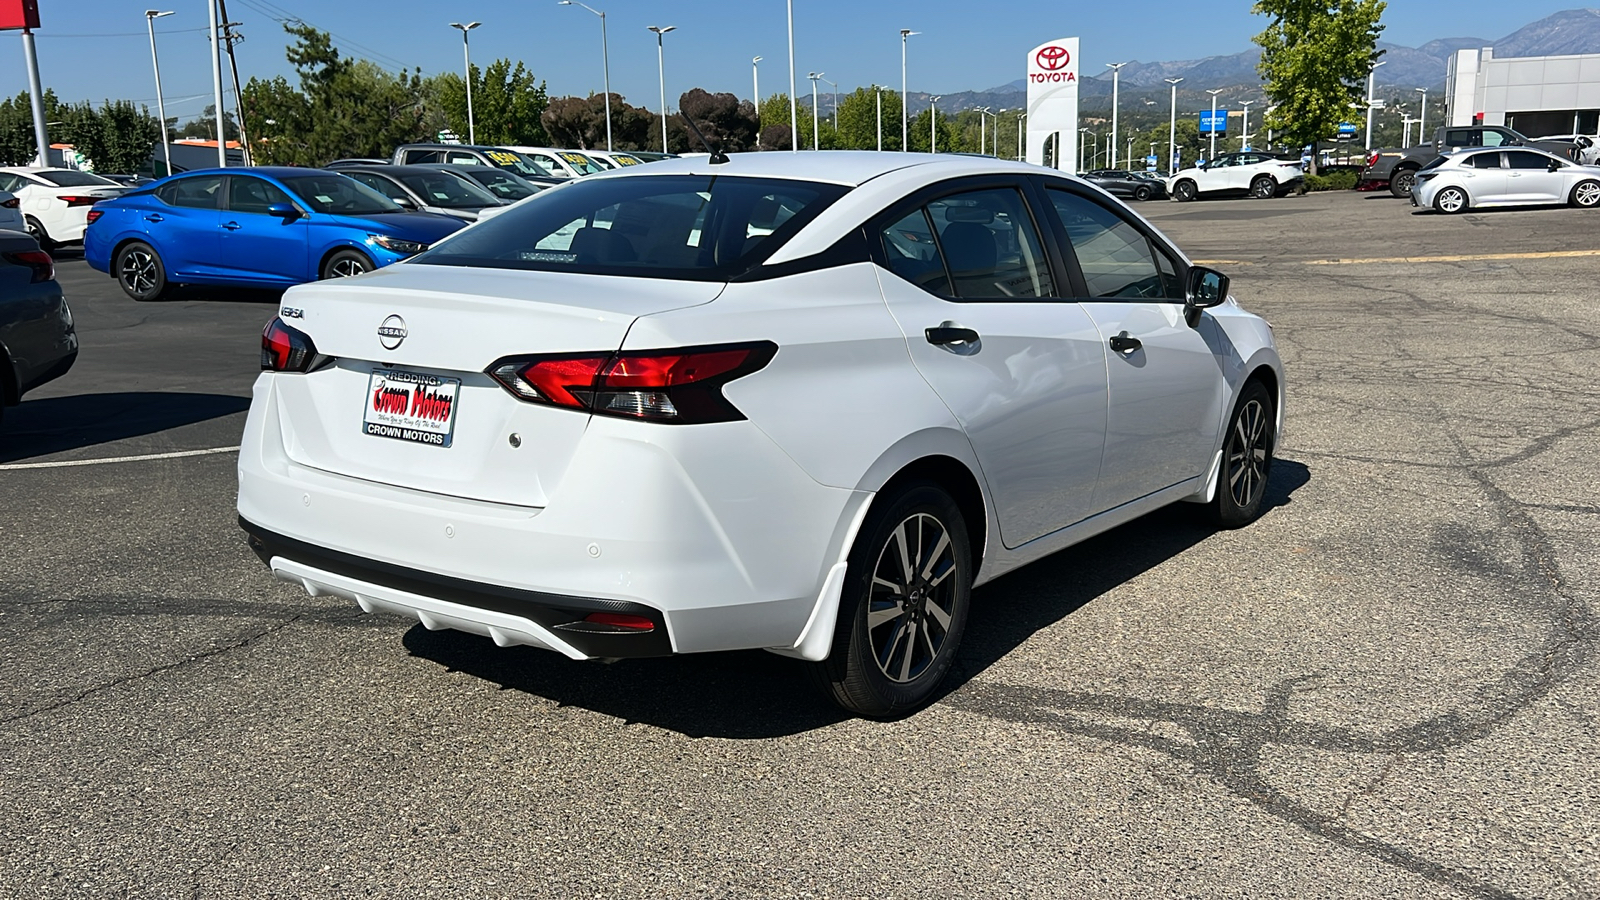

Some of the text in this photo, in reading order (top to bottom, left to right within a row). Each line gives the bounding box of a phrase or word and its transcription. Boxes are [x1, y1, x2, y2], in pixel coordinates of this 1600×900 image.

[1030, 72, 1076, 83] TOYOTA
[281, 305, 305, 320] VERSA
[378, 327, 407, 337] NISSAN
[391, 372, 437, 385] REDDING
[373, 386, 452, 422] Crown Motors
[367, 424, 443, 444] CROWN MOTORS
